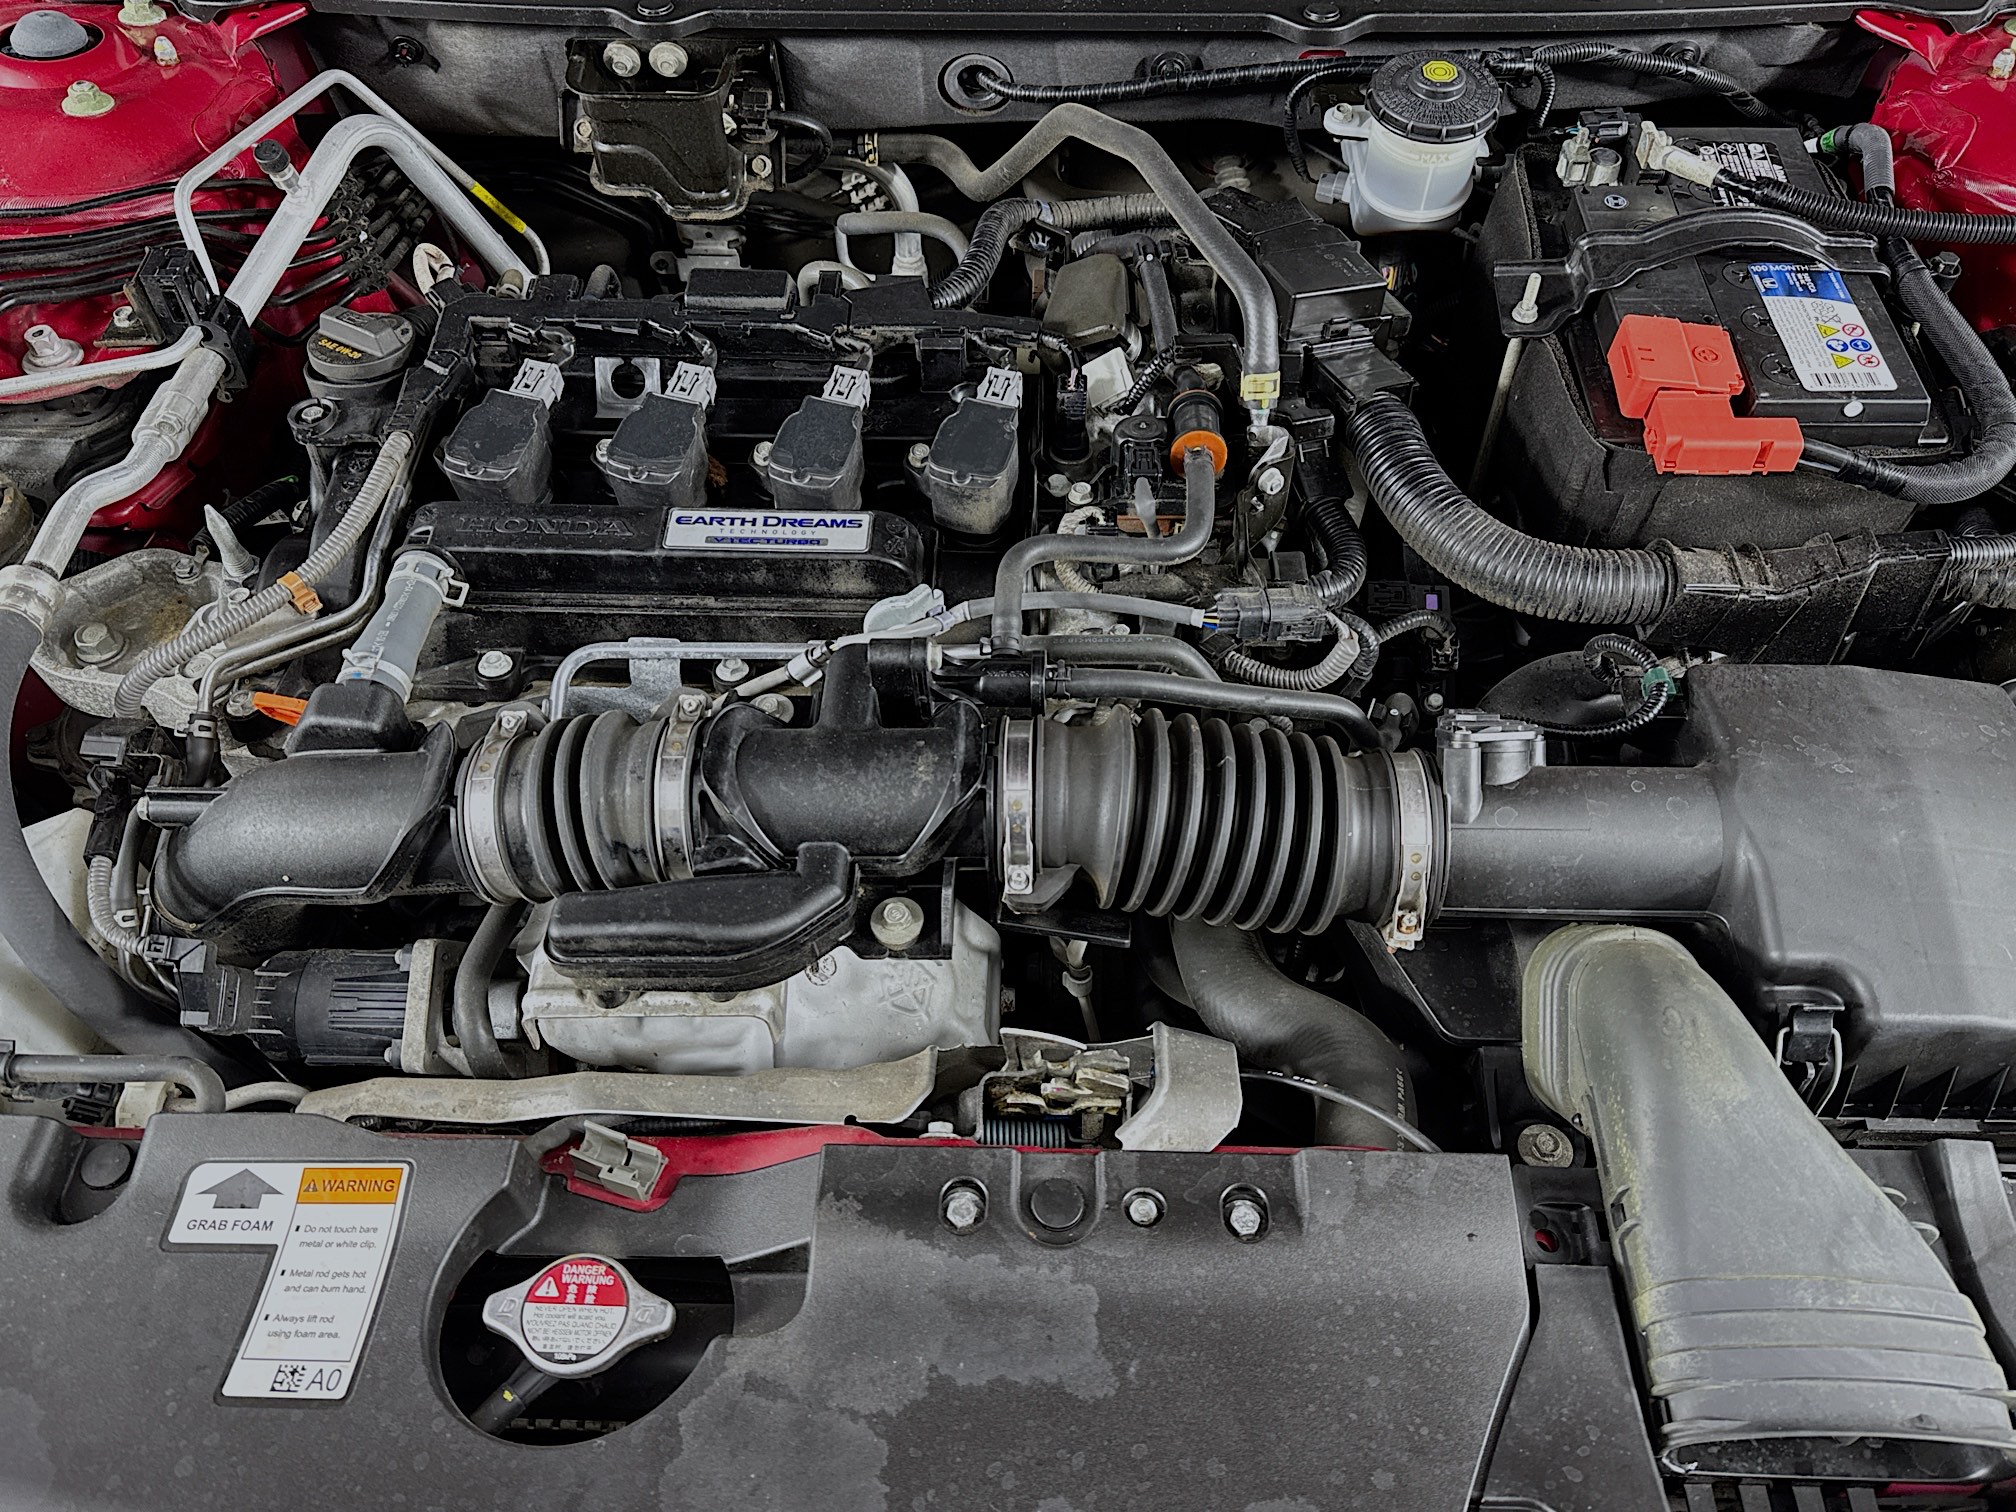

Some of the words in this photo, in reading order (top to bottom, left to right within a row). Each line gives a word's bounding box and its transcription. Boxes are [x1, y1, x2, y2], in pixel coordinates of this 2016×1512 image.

[318, 339, 339, 350] SAE
[335, 346, 362, 359] 0W-20
[456, 517, 634, 536] HONDA
[675, 515, 757, 527] EARTH
[762, 516, 863, 529] DREAMS
[719, 528, 817, 536] TECHNOLOGY
[322, 1179, 396, 1193] WARNING
[186, 1219, 229, 1231] GRAB
[231, 1220, 274, 1232] FOAM
[304, 1225, 316, 1233] Do
[318, 1225, 333, 1233] not
[334, 1225, 357, 1234] touch
[359, 1225, 378, 1234] bare
[299, 1239, 324, 1248] metal
[335, 1240, 358, 1249] white
[359, 1240, 377, 1251] clip.
[289, 1269, 314, 1278] Metal
[315, 1270, 330, 1278] rod
[331, 1270, 350, 1280] gets
[352, 1270, 367, 1279] hot
[562, 1264, 607, 1275] DANGER
[561, 1273, 614, 1285] WARNUNG
[283, 1284, 301, 1293] and
[320, 1285, 341, 1294] burn
[342, 1285, 367, 1294] hand.
[273, 1314, 305, 1325] Always
[306, 1314, 318, 1323] lift
[319, 1315, 335, 1324] rod
[267, 1330, 291, 1340] using
[293, 1330, 317, 1338] foam
[318, 1331, 341, 1339] area.
[305, 1367, 343, 1392] A0
